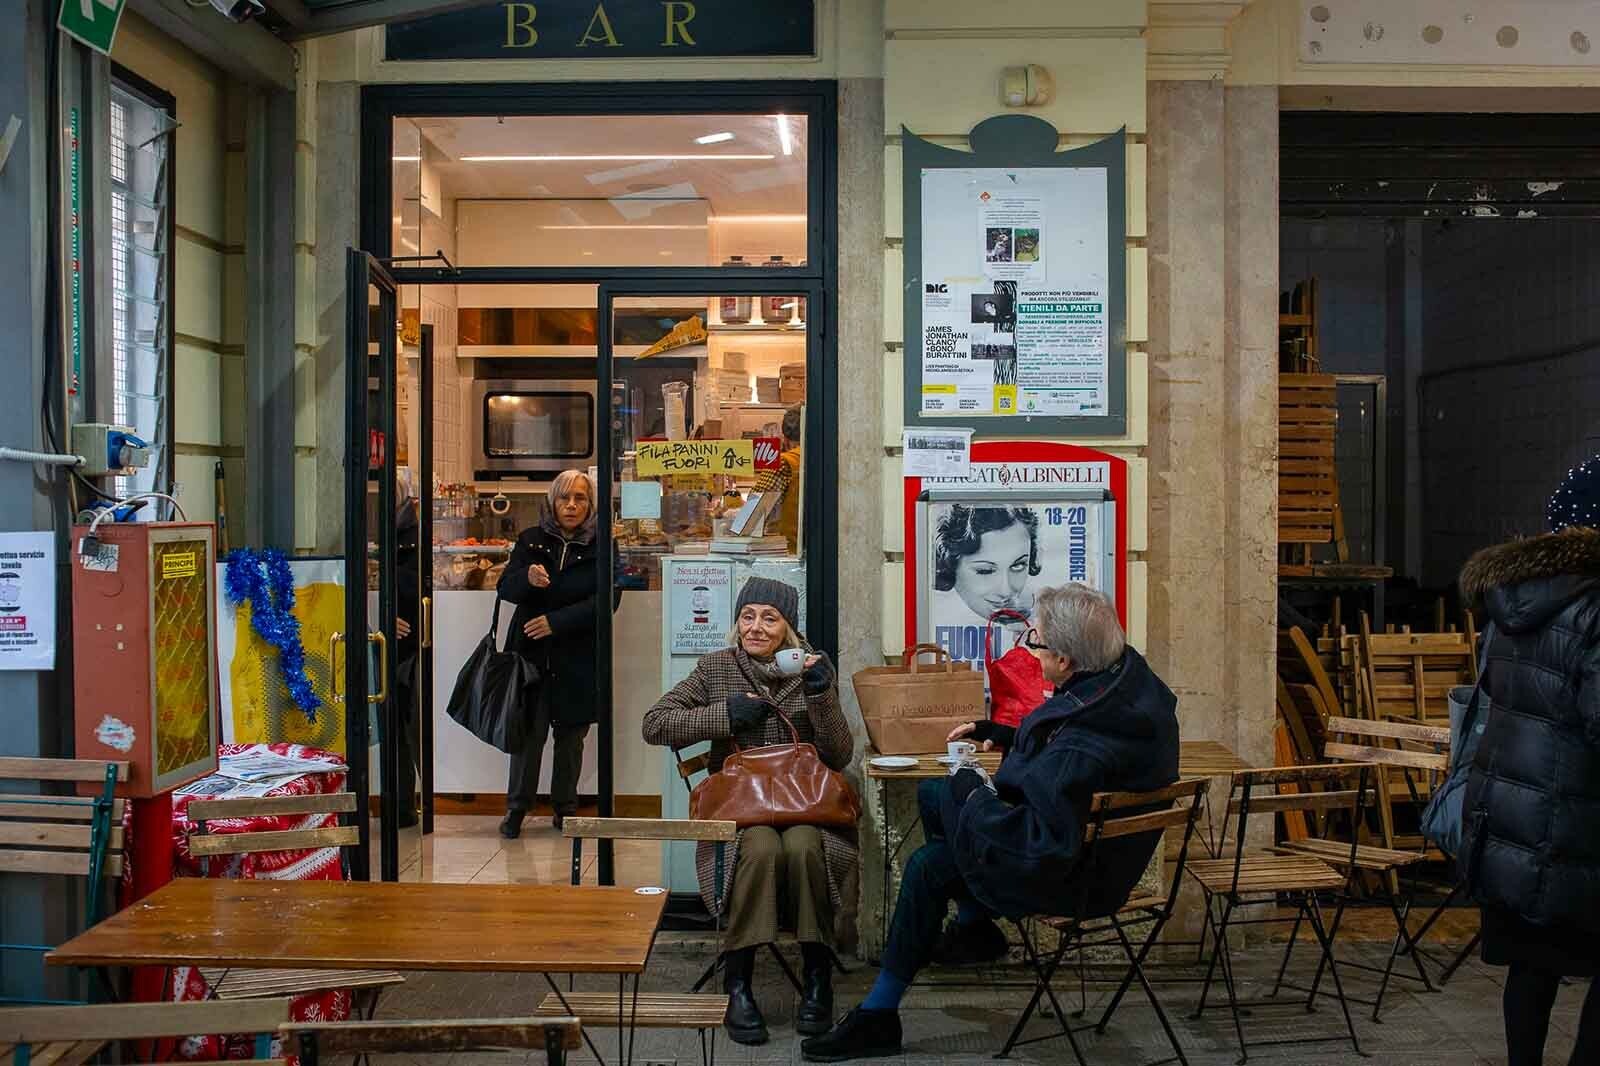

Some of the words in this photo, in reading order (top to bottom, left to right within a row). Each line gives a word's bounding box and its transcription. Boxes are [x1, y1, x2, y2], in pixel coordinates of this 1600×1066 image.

[502, 2, 696, 48] BAR
[754, 442, 779, 466] illy
[1012, 468, 1102, 483] ALBINELLI
[1045, 507, 1086, 525] 18-20
[1069, 527, 1086, 581] OTTOBRE
